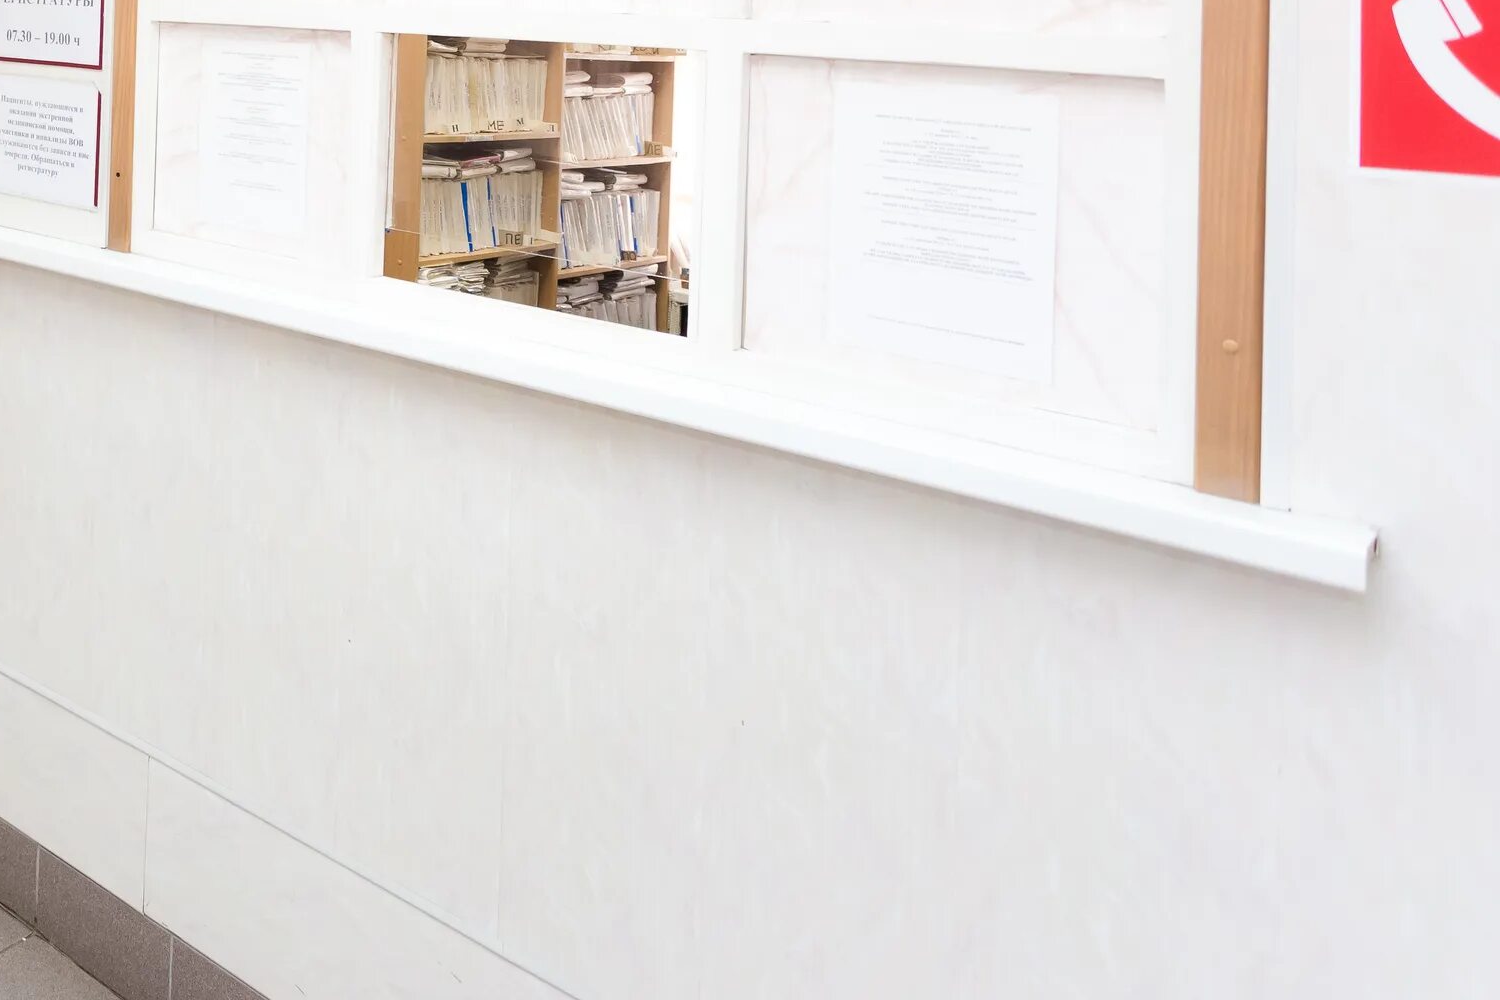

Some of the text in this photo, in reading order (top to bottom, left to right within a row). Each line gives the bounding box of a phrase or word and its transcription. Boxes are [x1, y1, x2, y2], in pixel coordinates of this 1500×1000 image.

[6, 29, 32, 42] 07.30
[45, 32, 70, 45] 19.00
[74, 37, 80, 46] ч
[39, 113, 73, 122] экстренной
[488, 121, 504, 130] МЕ
[68, 138, 84, 147] ВОВ
[31, 153, 69, 166] Обращаться
[18, 163, 59, 177] регистратуру
[505, 233, 521, 245] ПЕ
